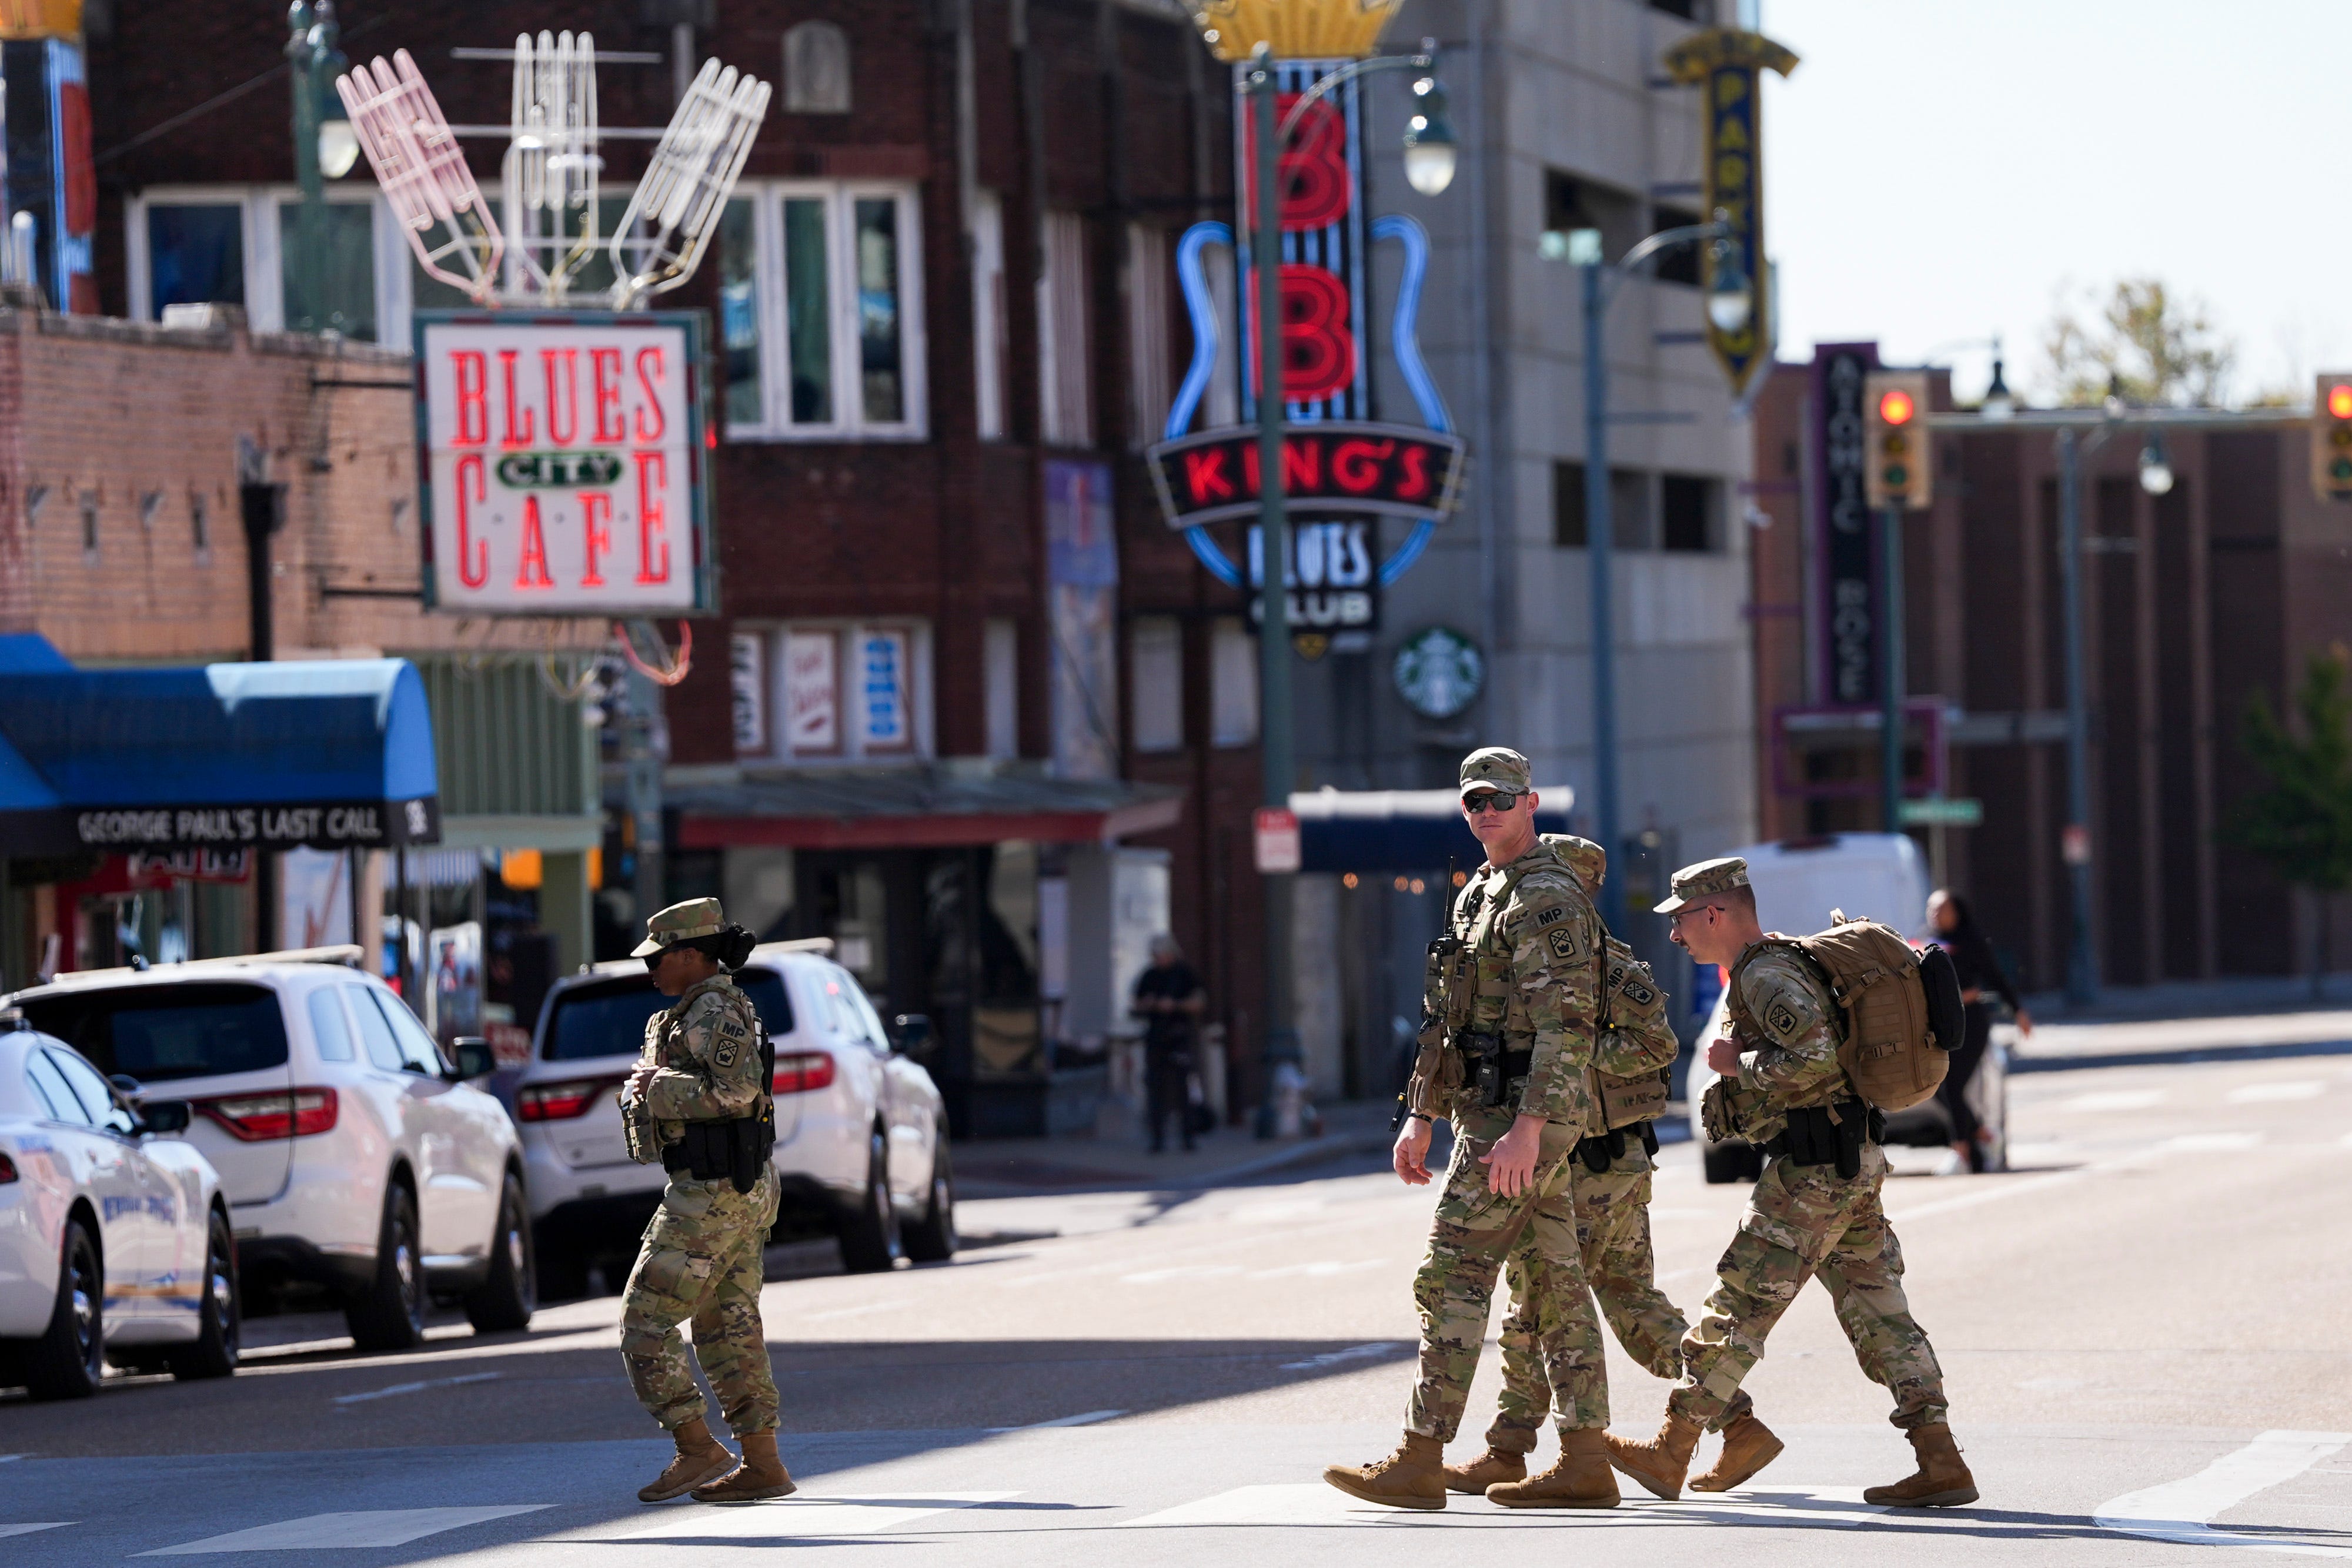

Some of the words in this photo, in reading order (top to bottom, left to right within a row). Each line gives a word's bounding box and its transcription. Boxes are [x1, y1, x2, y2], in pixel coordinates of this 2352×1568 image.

[449, 346, 665, 450] BLUES
[501, 455, 614, 484] CITY
[1184, 437, 1432, 506] KING'S
[455, 450, 670, 590] CAFE
[78, 811, 171, 842] GEORGE
[176, 808, 255, 841] PAUL'S
[262, 808, 322, 840] LAST
[326, 807, 382, 840] CALL
[1538, 908, 1562, 925] MP
[1608, 968, 1623, 988] MP
[722, 1022, 745, 1038] MP
